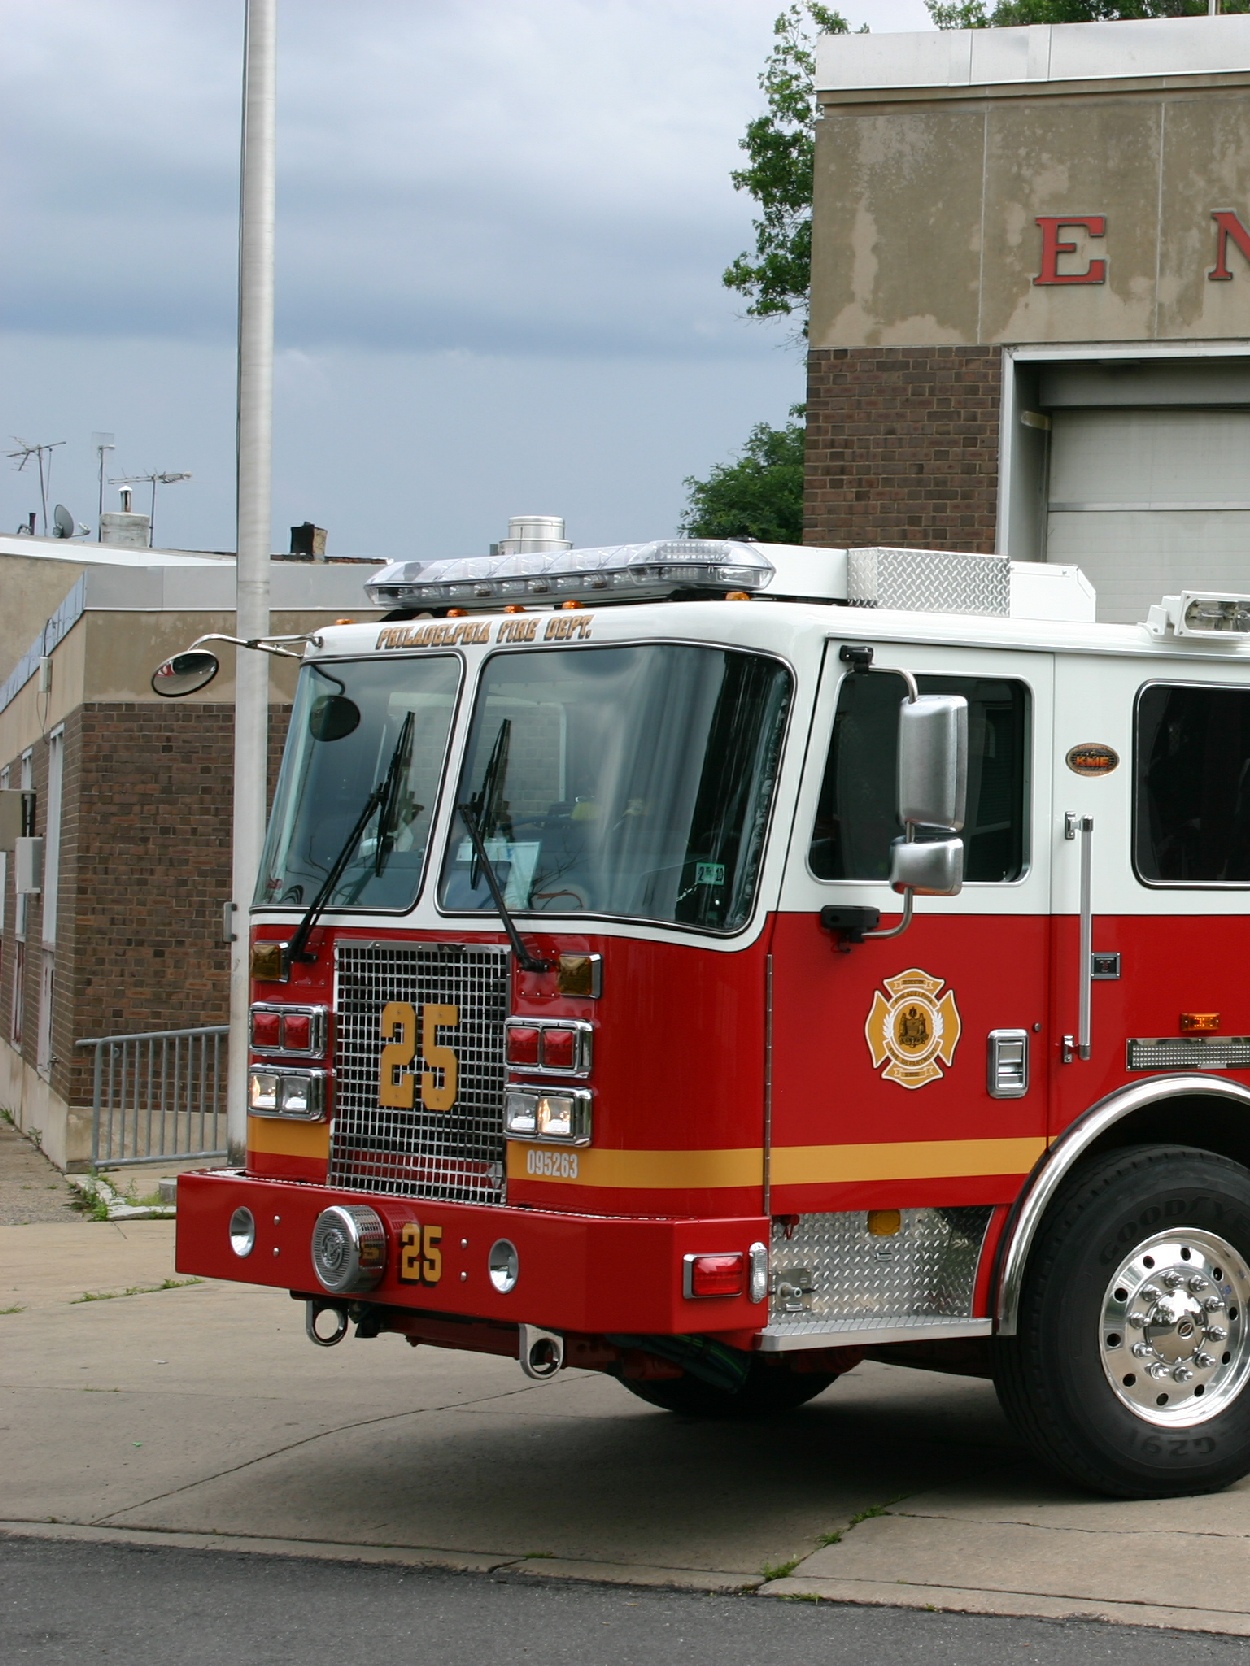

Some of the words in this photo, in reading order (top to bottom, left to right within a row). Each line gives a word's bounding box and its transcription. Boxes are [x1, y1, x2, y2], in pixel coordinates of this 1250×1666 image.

[375, 621, 492, 650] PHILADELPHIA
[497, 618, 541, 644] FIRE
[543, 614, 595, 641] DEPT.
[1075, 755, 1109, 767] KME
[379, 1001, 459, 1110] 25
[527, 1149, 578, 1179] 095263
[400, 1222, 442, 1284] 25
